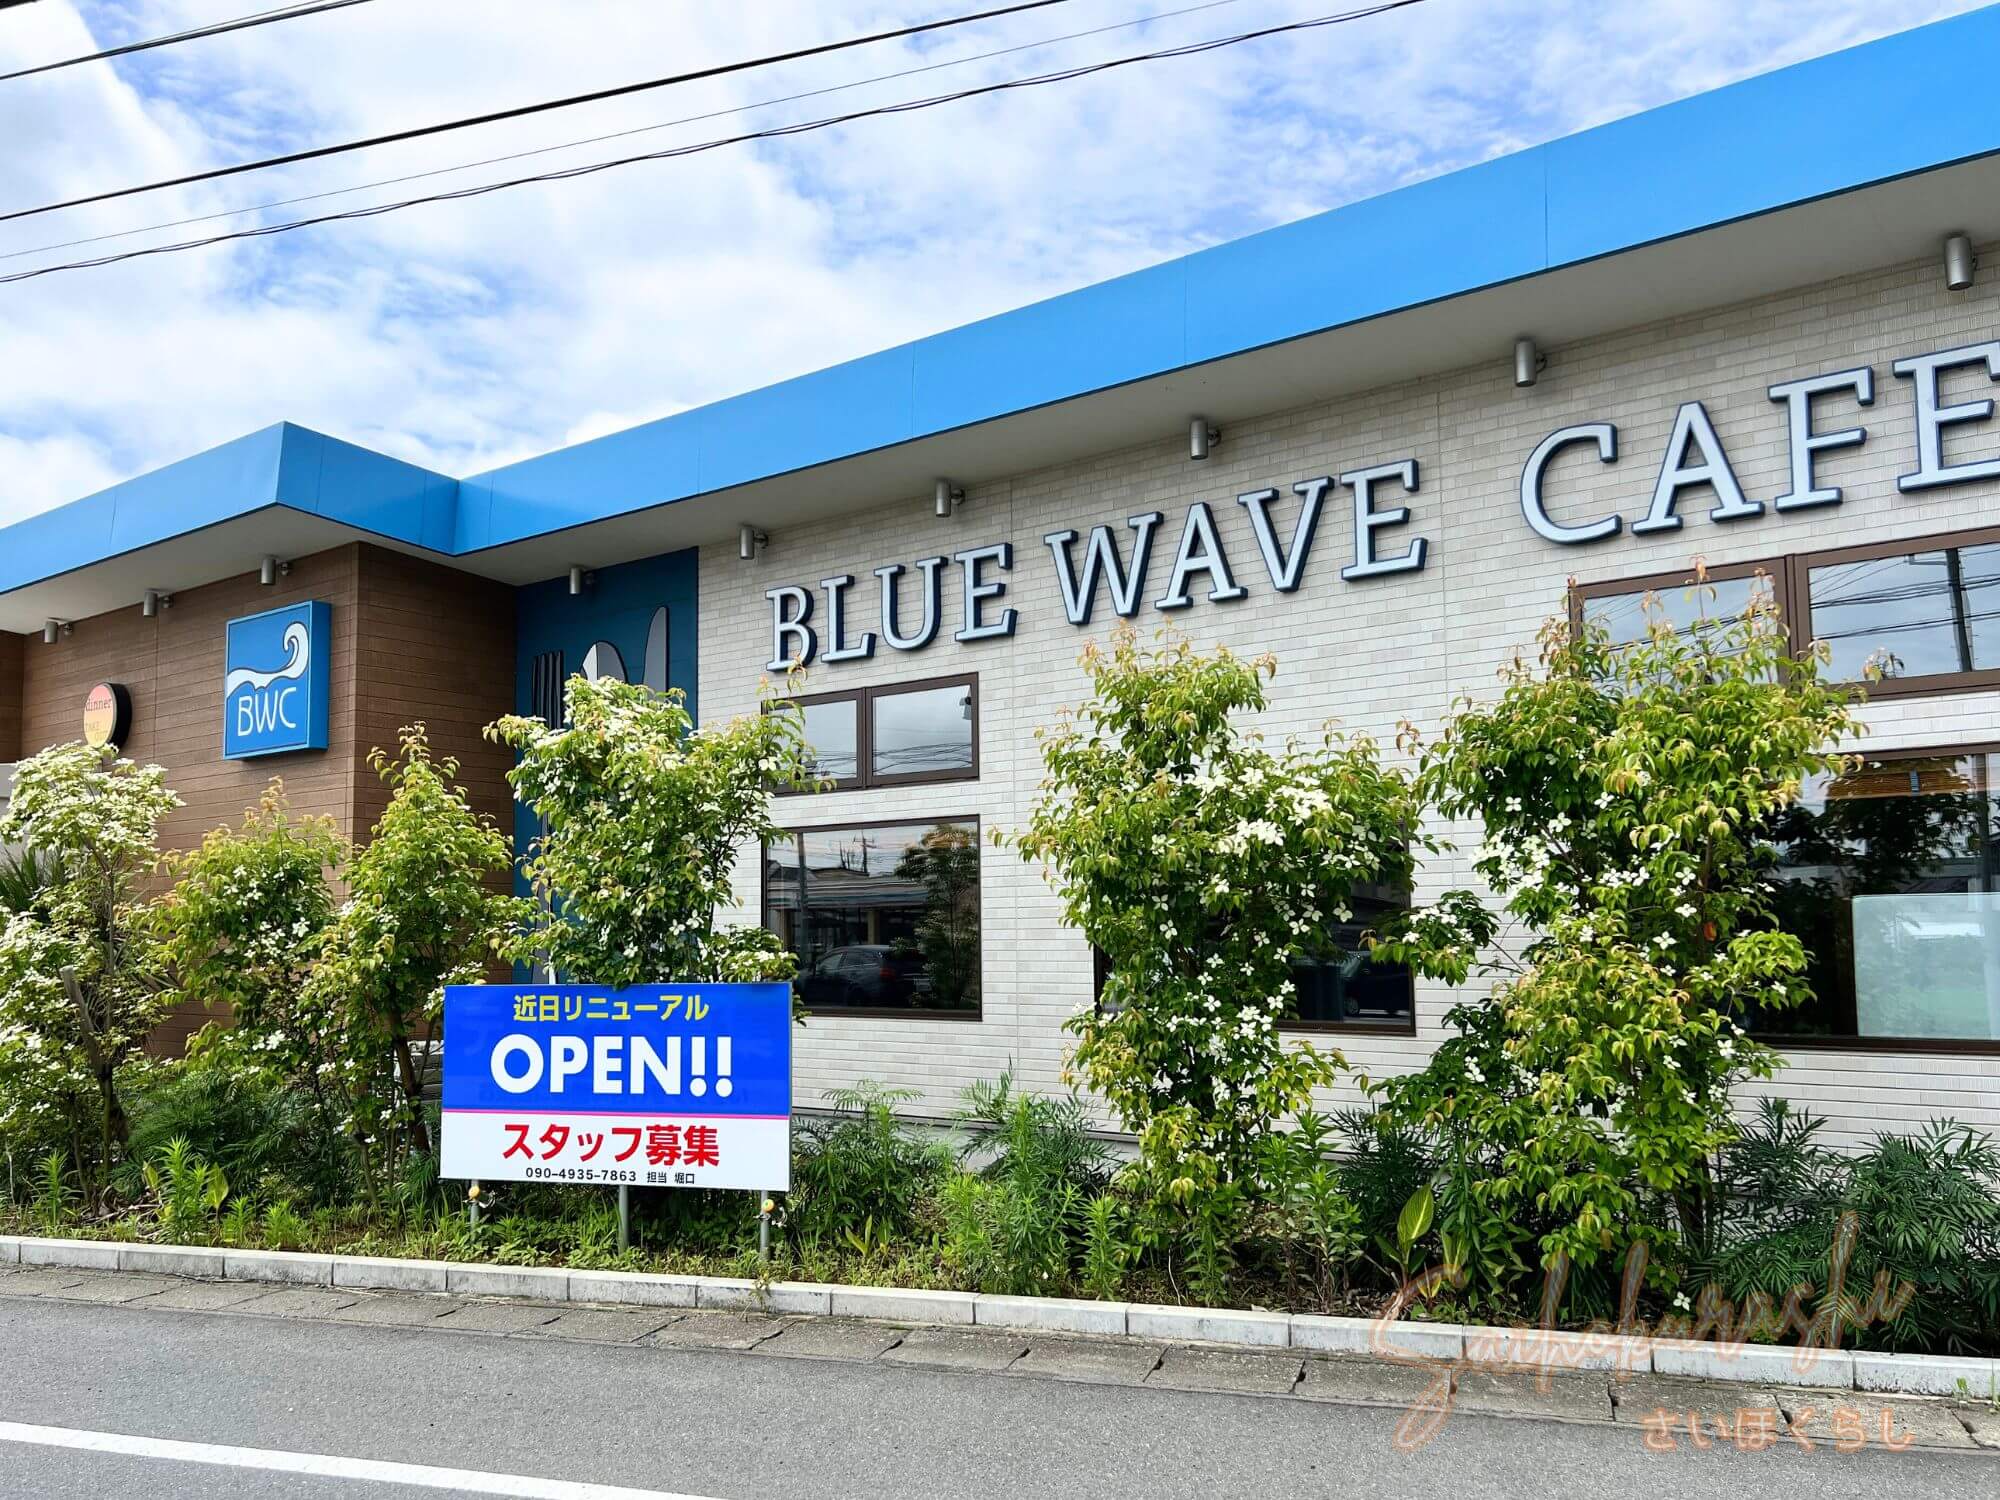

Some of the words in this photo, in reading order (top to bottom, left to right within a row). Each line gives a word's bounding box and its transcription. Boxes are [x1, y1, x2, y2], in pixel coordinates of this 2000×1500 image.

[766, 542, 1018, 672] BLUE
[1044, 457, 1428, 625] WAVE
[1519, 339, 2000, 546] CAFE
[237, 686, 297, 737] BWC
[513, 994, 709, 1022] 近日リニューアル
[490, 1033, 733, 1098] OPEN!!
[502, 1123, 720, 1167] スタッフ募集
[525, 1167, 637, 1182] 090-4935-7863
[646, 1171, 668, 1184] 担当
[674, 1172, 696, 1185] 堀口
